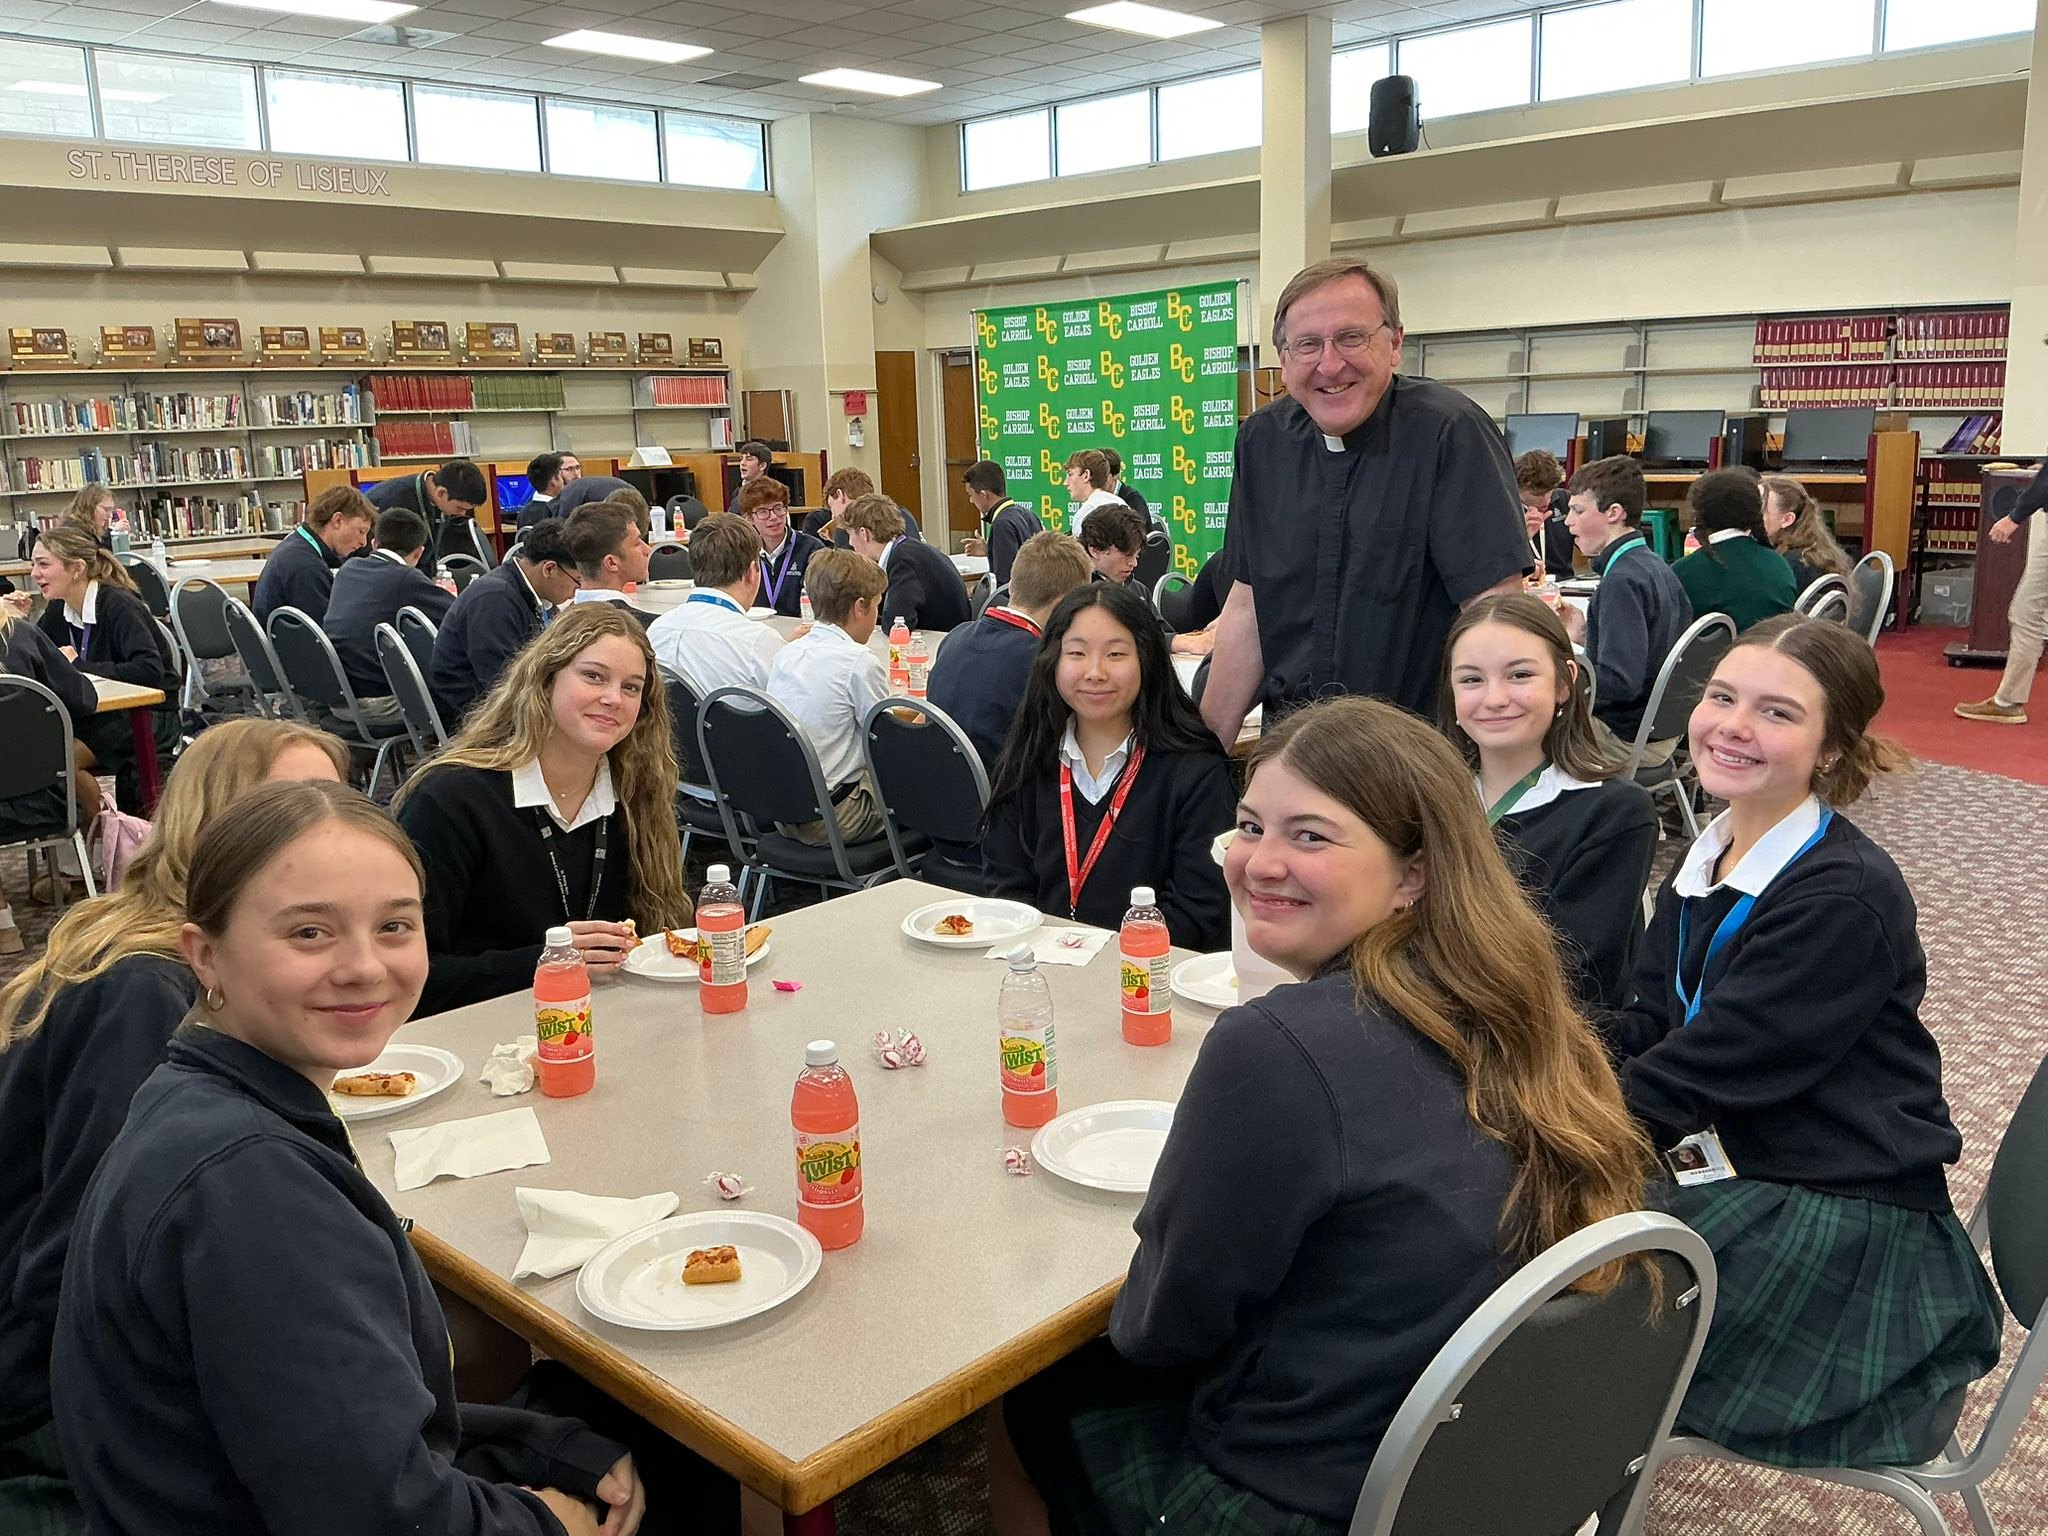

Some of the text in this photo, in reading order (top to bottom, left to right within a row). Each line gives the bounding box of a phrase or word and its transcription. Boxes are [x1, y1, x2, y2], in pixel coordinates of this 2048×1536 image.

[67, 150, 390, 196] ST. THERESE OF LISIEUX
[1199, 292, 1232, 308] GOLDEN
[1130, 302, 1158, 317] BISHOP
[1200, 308, 1234, 323] EAGLES
[1003, 315, 1028, 328] BISHOP
[1063, 310, 1090, 323] GOLDEN
[1127, 316, 1163, 332] CARROLL
[1001, 328, 1032, 342] CARROLL
[1064, 324, 1092, 338] EAGLES
[1129, 352, 1159, 367] GOLDEN
[1203, 346, 1234, 360] BISHOP
[1003, 363, 1029, 375] GOLDEN
[1067, 359, 1092, 372] BISHOP
[1201, 361, 1238, 375] CARROLL
[1064, 373, 1097, 386] CARROLL
[1131, 367, 1161, 381] EAGLES
[1004, 376, 1030, 388] EAGLES
[1133, 404, 1160, 417] BISHOP
[1202, 399, 1234, 413] GOLDEN
[1005, 410, 1030, 422] BISHOP
[1066, 408, 1093, 420] GOLDEN
[1067, 421, 1095, 433] EAGLES
[1130, 418, 1167, 431] CARROLL
[1203, 414, 1234, 428] EAGLES
[1003, 423, 1034, 435] CARROLL
[1005, 456, 1032, 467] GOLDEN
[1132, 453, 1161, 465] GOLDEN
[1006, 468, 1033, 480] EAGLES
[1133, 468, 1163, 480] EAGLES
[1204, 502, 1229, 514] GOLDE
[1205, 516, 1226, 528] EAGL
[1001, 1045, 1045, 1070] TWIST
[800, 1149, 852, 1184] TWIST
